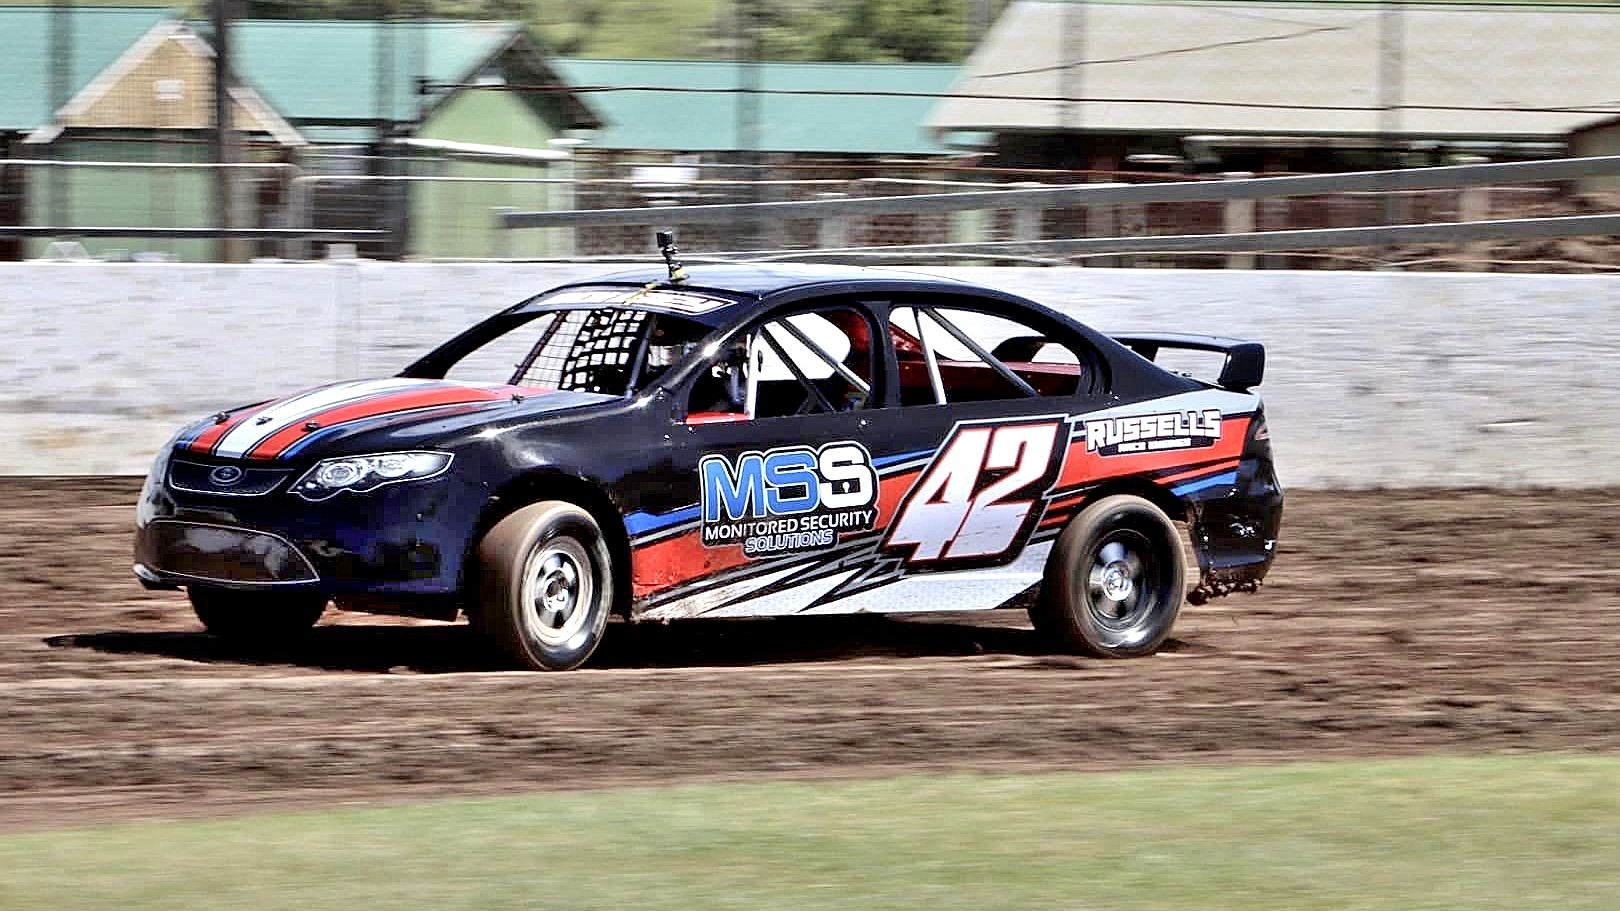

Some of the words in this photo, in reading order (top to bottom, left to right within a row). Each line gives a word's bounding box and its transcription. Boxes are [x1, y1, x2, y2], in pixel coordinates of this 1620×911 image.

[1086, 409, 1221, 452] RUSSELLS
[702, 445, 873, 523] MSS
[886, 422, 1060, 563] 42
[705, 519, 798, 541] MONITORED
[800, 510, 873, 531] SECURITY
[745, 529, 834, 553] SOLUTIONS
